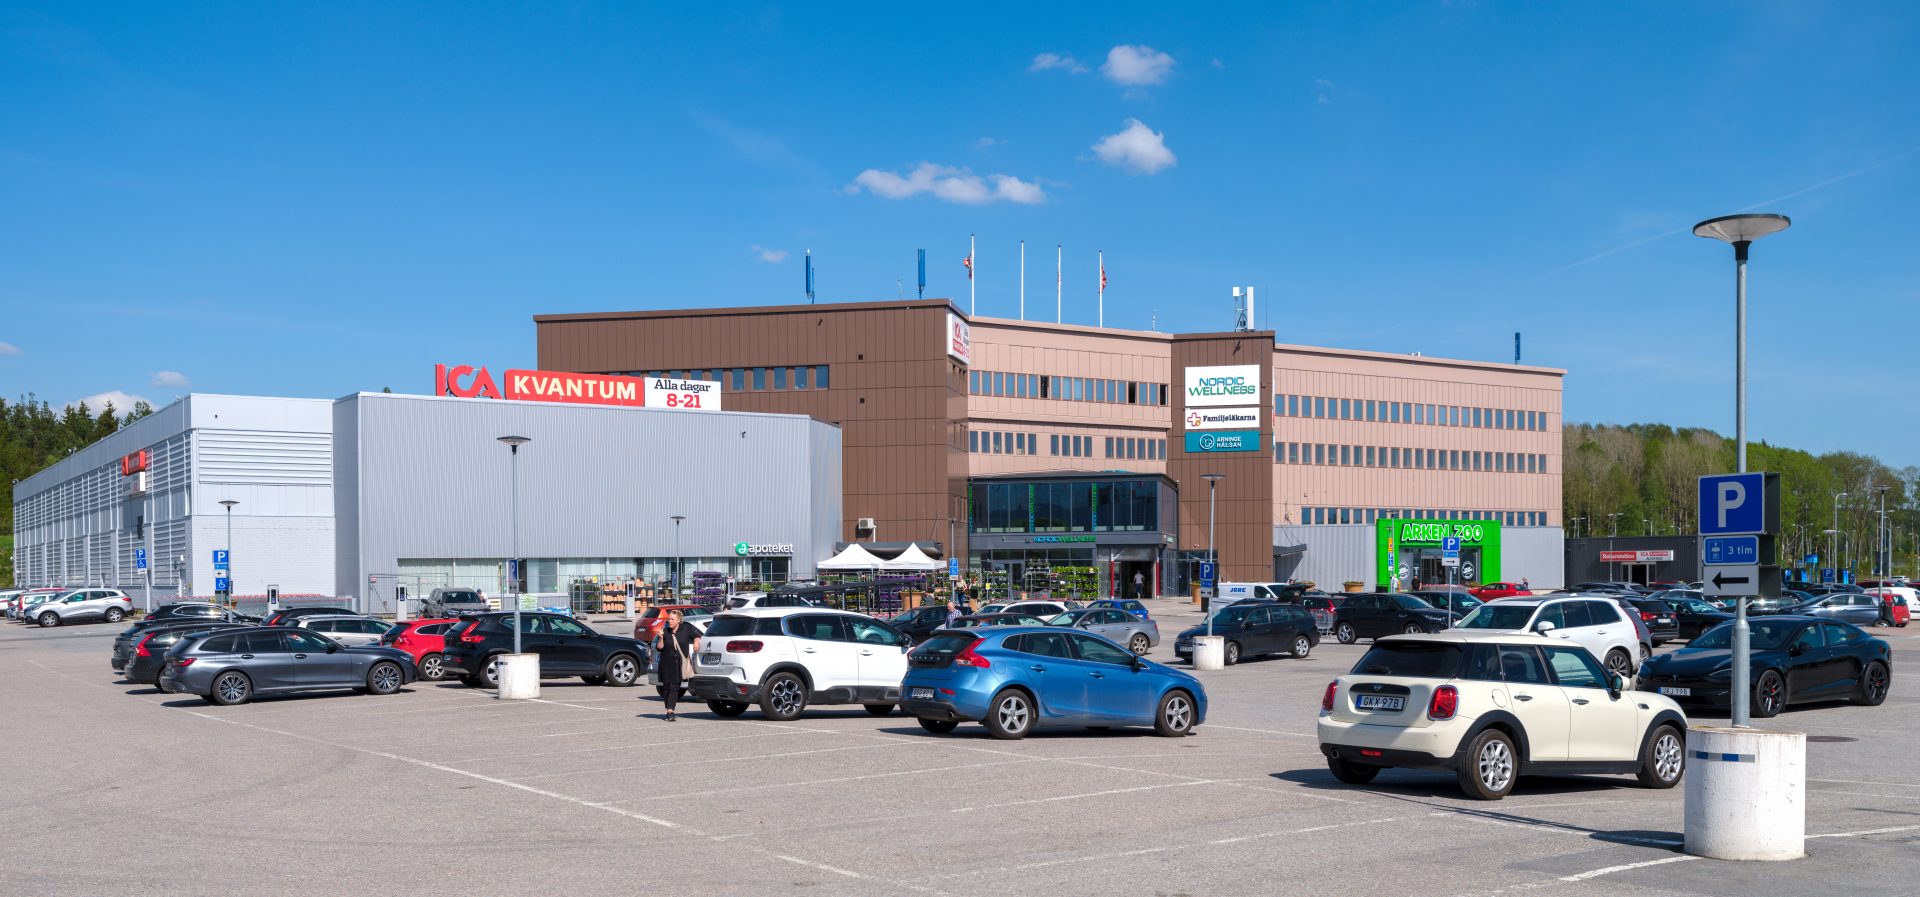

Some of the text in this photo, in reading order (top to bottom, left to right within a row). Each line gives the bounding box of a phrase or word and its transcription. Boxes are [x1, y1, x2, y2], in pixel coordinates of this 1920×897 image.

[435, 363, 636, 400] ICA KVANTUM
[654, 378, 711, 393] Alla dagar
[1199, 377, 1245, 387] NORDIC
[1189, 386, 1256, 396] WELLNESS
[666, 393, 702, 409] 8-21
[1203, 414, 1256, 422] Familjeläkarna
[1718, 481, 1746, 528] P
[1401, 523, 1484, 542] ARKEN ZOO
[749, 543, 794, 555] apoteket
[1447, 539, 1455, 549] P
[1728, 545, 1752, 555] 3 tim
[138, 550, 143, 558] P
[217, 551, 226, 562] P
[1203, 564, 1210, 578] P
[1363, 696, 1400, 708] GKX 97B
